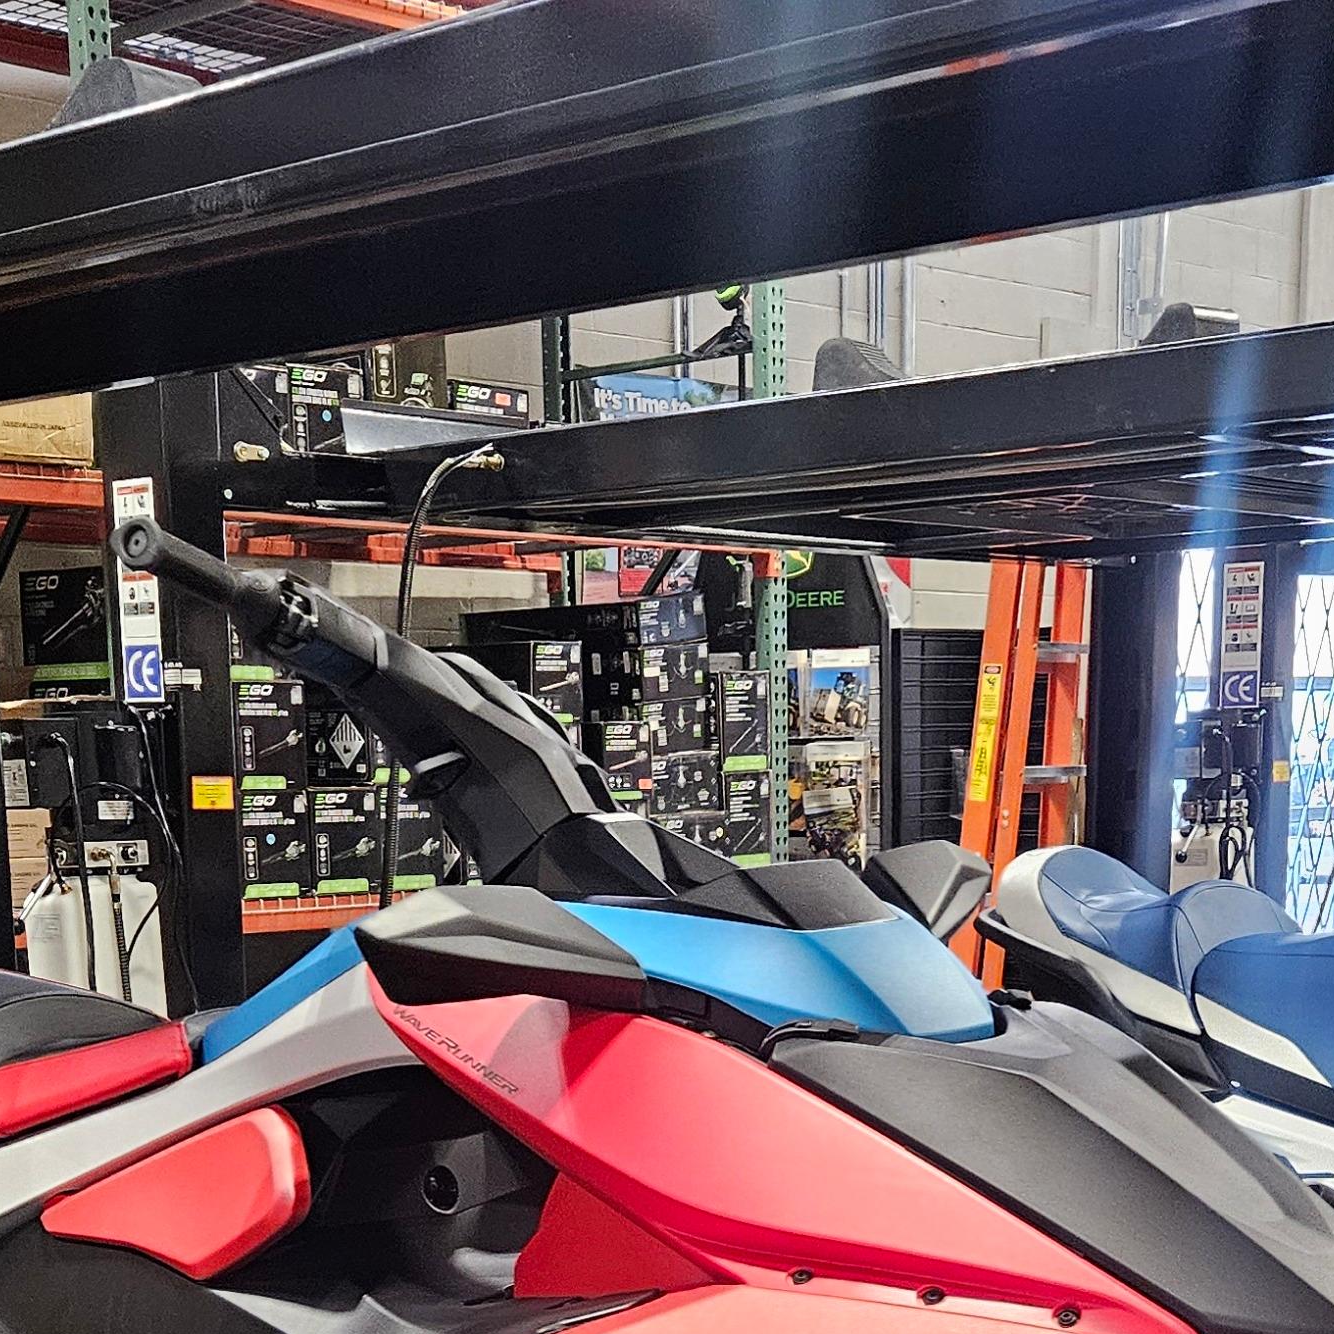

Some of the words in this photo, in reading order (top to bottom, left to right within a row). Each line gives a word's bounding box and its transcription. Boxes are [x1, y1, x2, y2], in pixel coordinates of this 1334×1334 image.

[292, 369, 327, 382] EGO
[456, 384, 490, 399] EGO
[594, 388, 622, 410] It's
[625, 391, 670, 414] Time
[25, 576, 59, 590] EGO
[536, 646, 563, 655] EGO
[129, 650, 158, 693] CE
[239, 685, 274, 695] EGO
[726, 681, 753, 690] EGO
[1224, 674, 1254, 702] CE
[606, 726, 632, 734] EGO
[730, 780, 756, 790] EGO
[243, 796, 276, 806] EGO
[315, 793, 347, 804] EGO
[393, 1004, 519, 1095] WAVERUNNER
